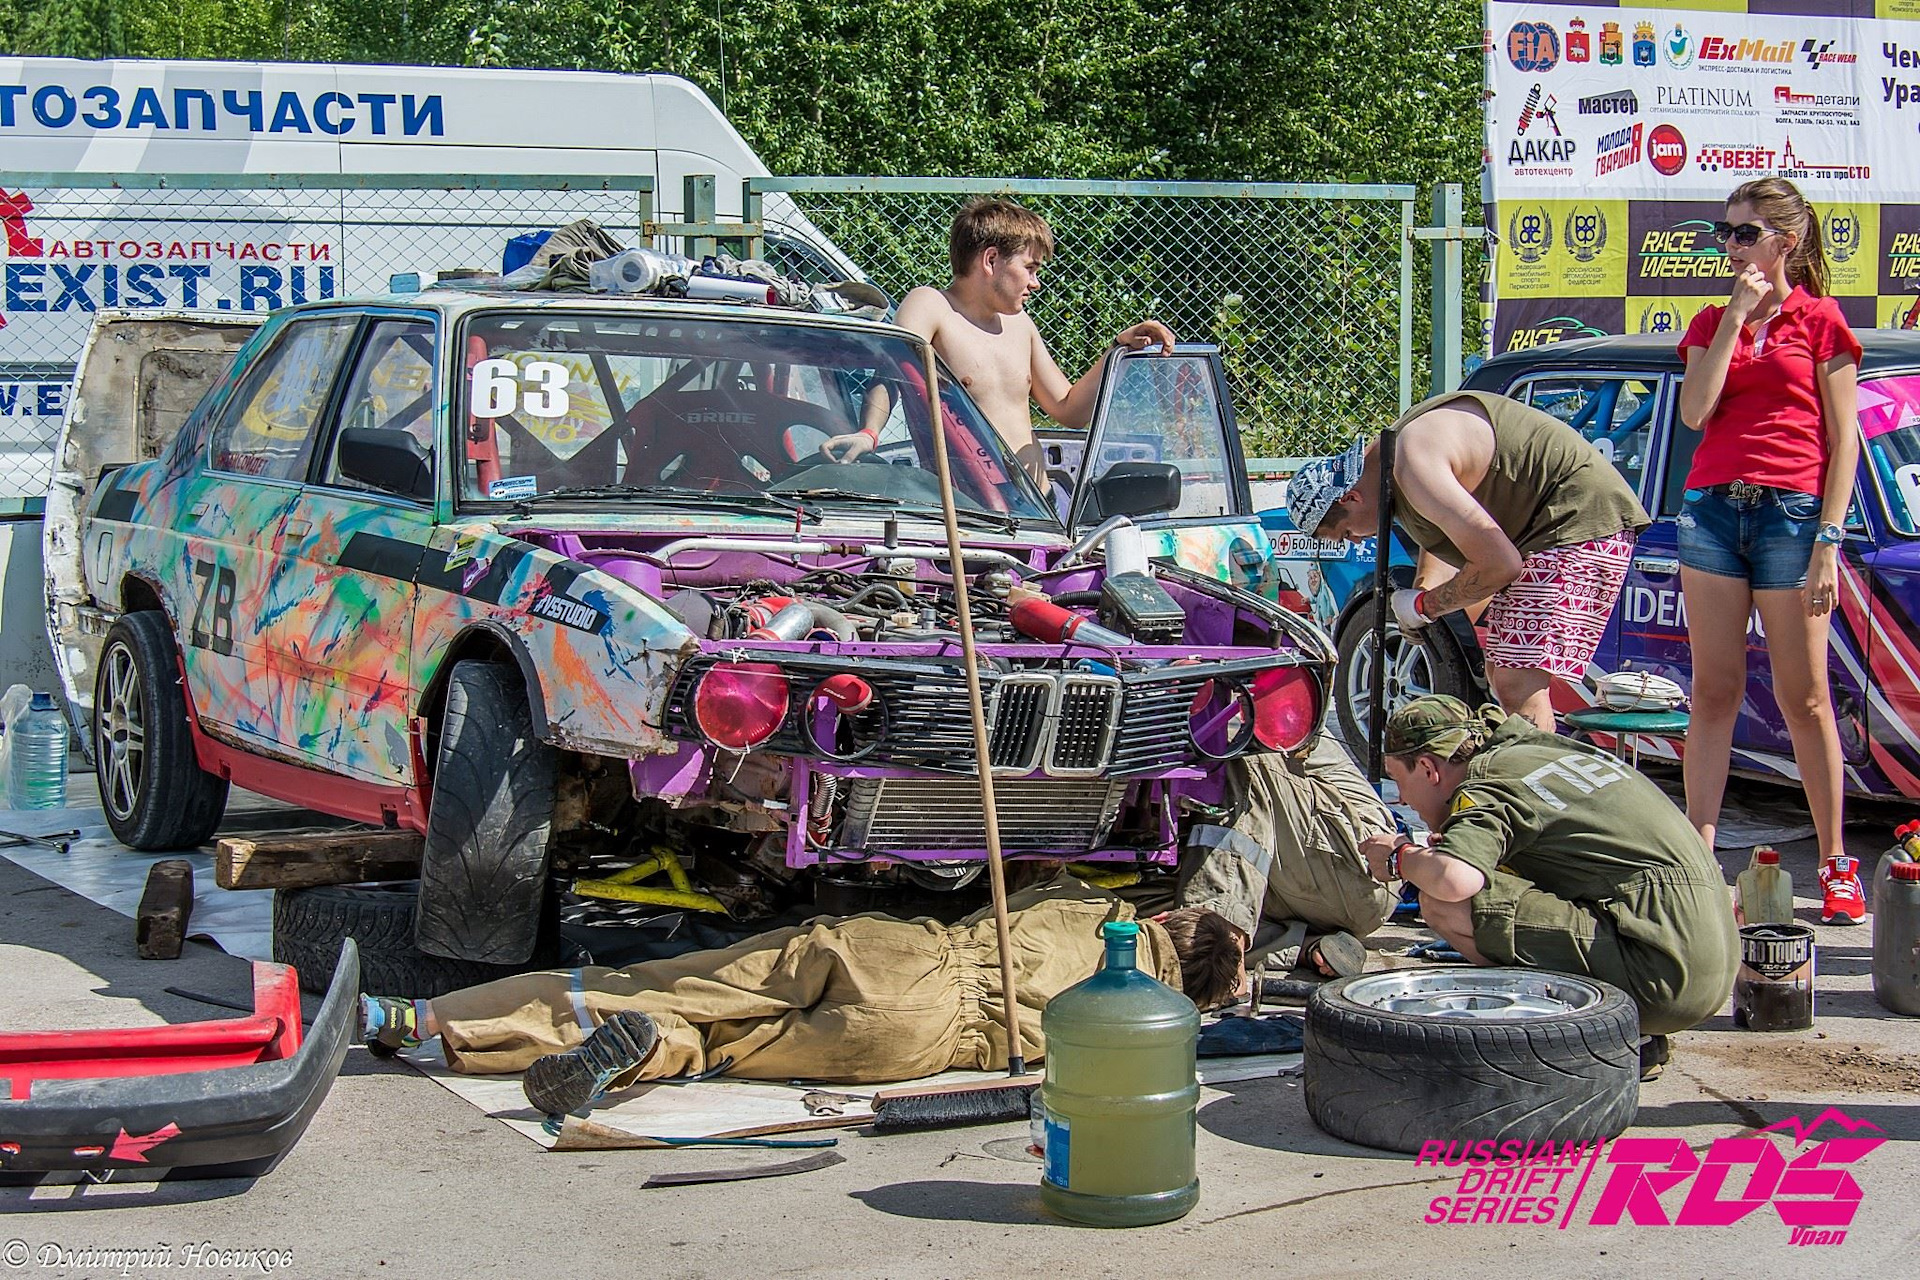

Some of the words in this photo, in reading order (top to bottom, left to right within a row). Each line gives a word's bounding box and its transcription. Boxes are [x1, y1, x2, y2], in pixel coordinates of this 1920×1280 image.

[1699, 37, 1797, 63] ExMail
[1818, 53, 1836, 62] RACE
[1837, 54, 1857, 63] WEAR
[1698, 65, 1754, 73] ЭКСПРЕСС-ДОСТАВКА
[1761, 67, 1792, 75] ЛОГИСТИКА
[1656, 86, 1753, 108] PLATINUM
[1508, 139, 1576, 166] ДАКАР
[1652, 138, 1683, 160] jam
[1723, 146, 1776, 169] ВЕЗЁТ
[1514, 167, 1574, 177] автотехцентр
[49, 240, 331, 261] АВТОЗАПЧАСТИ
[1641, 231, 1697, 253] RACE
[5, 263, 334, 313] EXIST.RU
[471, 358, 570, 418] 63
[687, 411, 757, 425] BRIDE
[1292, 536, 1346, 551] БОЛЬНИЦА
[1741, 938, 1765, 963] PRO
[1767, 939, 1808, 964] TOUCH
